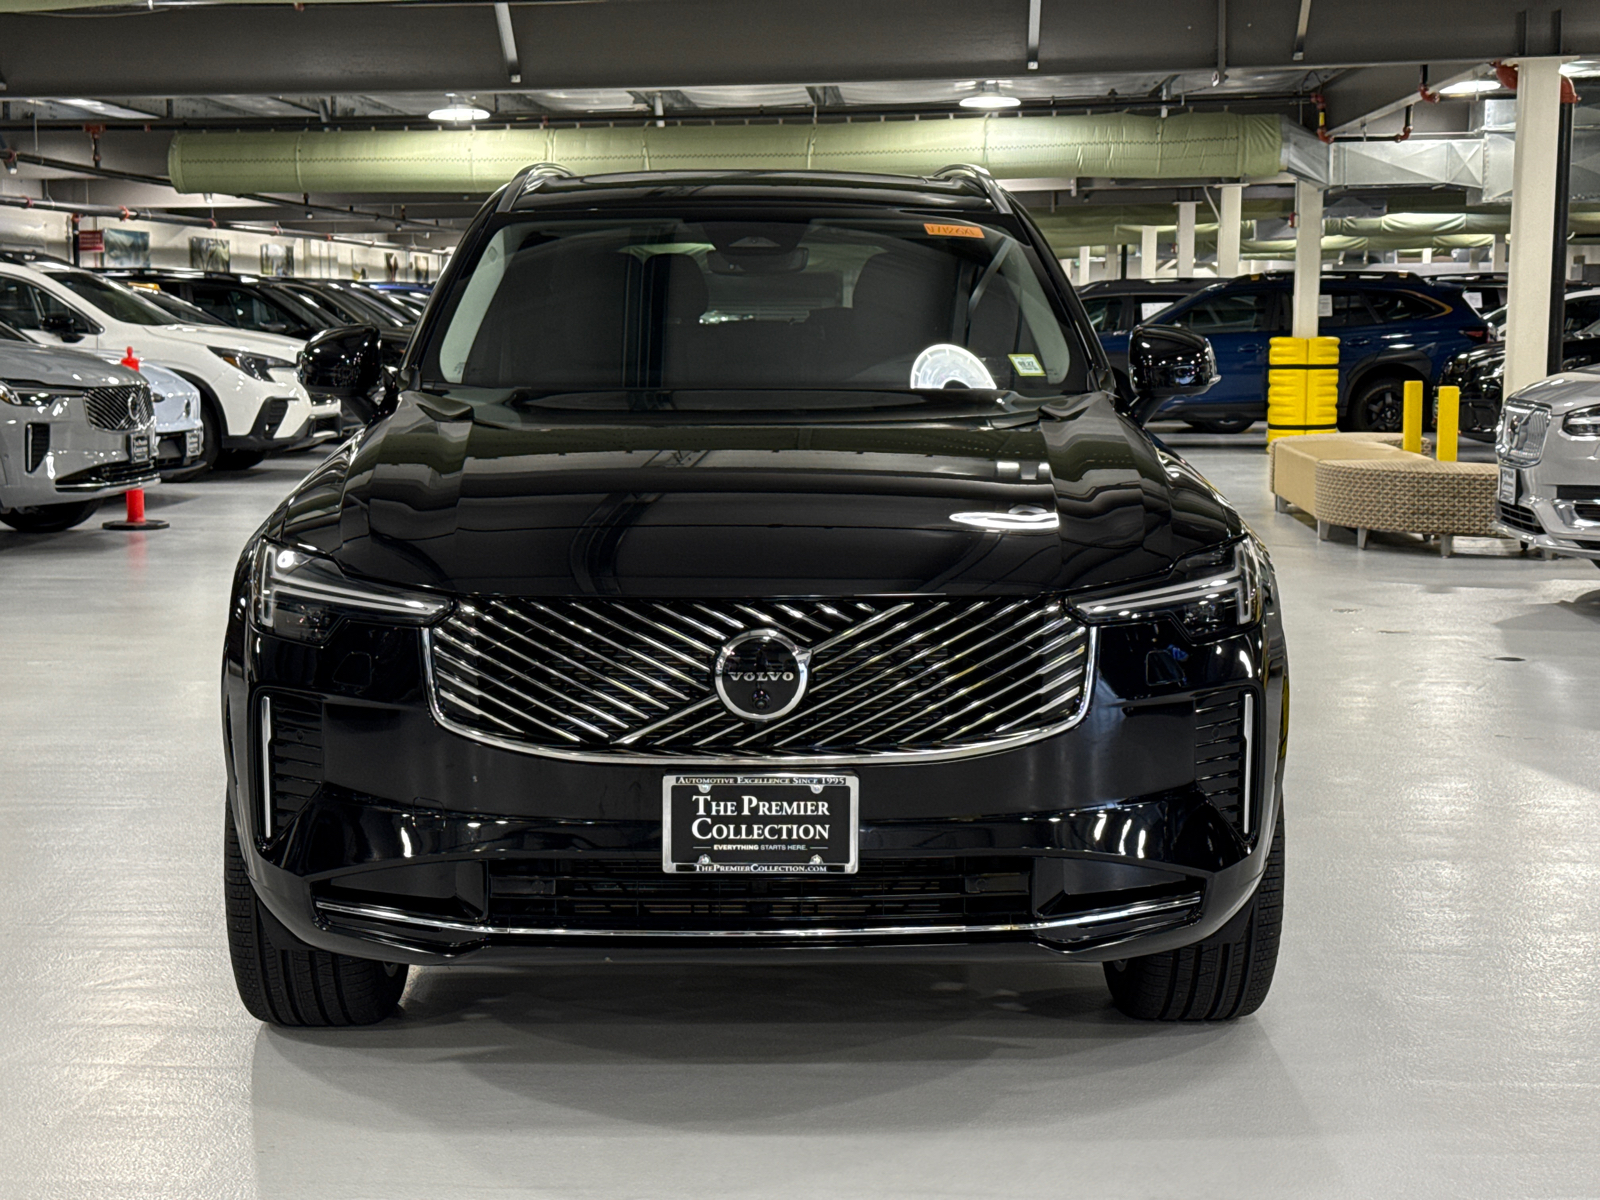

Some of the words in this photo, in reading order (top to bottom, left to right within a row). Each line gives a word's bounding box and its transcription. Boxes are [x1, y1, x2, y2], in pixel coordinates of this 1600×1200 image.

[728, 671, 794, 681] VOLVO
[677, 776, 735, 784] AUTOMOTIVE
[737, 776, 790, 784] EXCELLENCE
[792, 777, 819, 785] SINCE
[821, 777, 845, 785] 1995
[692, 795, 738, 816] THE
[741, 795, 830, 816] PREMIER
[691, 817, 830, 840] COLLECTION
[694, 863, 827, 873] THEPREMIERCOLLECTION.COM
